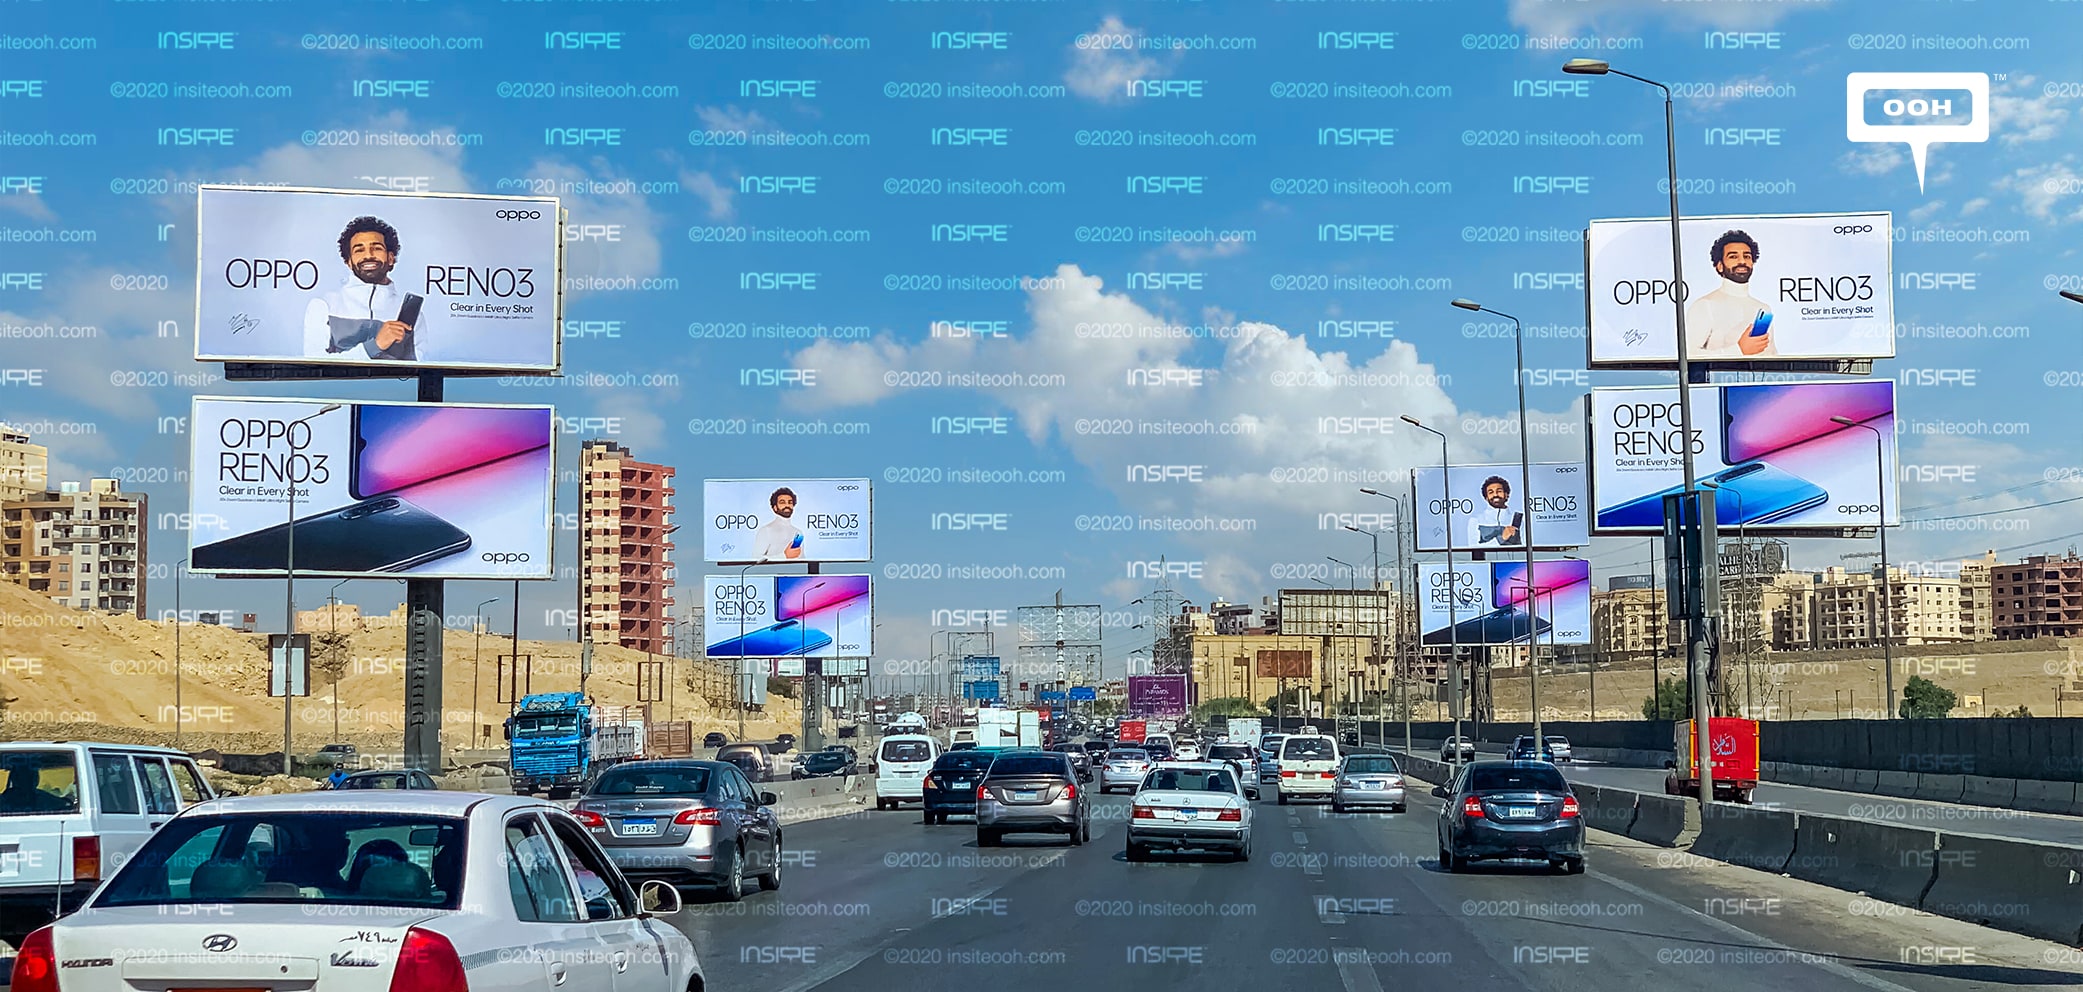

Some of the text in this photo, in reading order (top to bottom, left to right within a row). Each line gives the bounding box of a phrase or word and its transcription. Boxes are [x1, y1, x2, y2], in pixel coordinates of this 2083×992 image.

[495, 209, 541, 221] oppo
[1833, 224, 1873, 235] oppo
[225, 258, 535, 298] OPPO RENO3
[1613, 275, 1873, 305] OPPO RENO3
[450, 302, 534, 315] Clear in Every Shot
[1801, 305, 1874, 316] Clear in Every Shot
[1613, 403, 1683, 428] OPPO
[220, 418, 312, 450] OPPO
[1614, 429, 1704, 456] RENO3
[219, 452, 330, 484] RENO3
[1555, 466, 1578, 474] oppo
[1615, 457, 1684, 467] Clear in Every Sho
[219, 485, 309, 498] Clear in Every Shot
[1429, 495, 1577, 515] OPPO RENO3
[1838, 504, 1880, 515] oppo
[715, 513, 859, 530] OPPO RENO3
[481, 552, 530, 565] oppo
[1430, 571, 1474, 587] OPPO
[715, 584, 757, 600] OPPO
[1431, 587, 1483, 604] RENO3
[715, 600, 766, 616] RENO3
